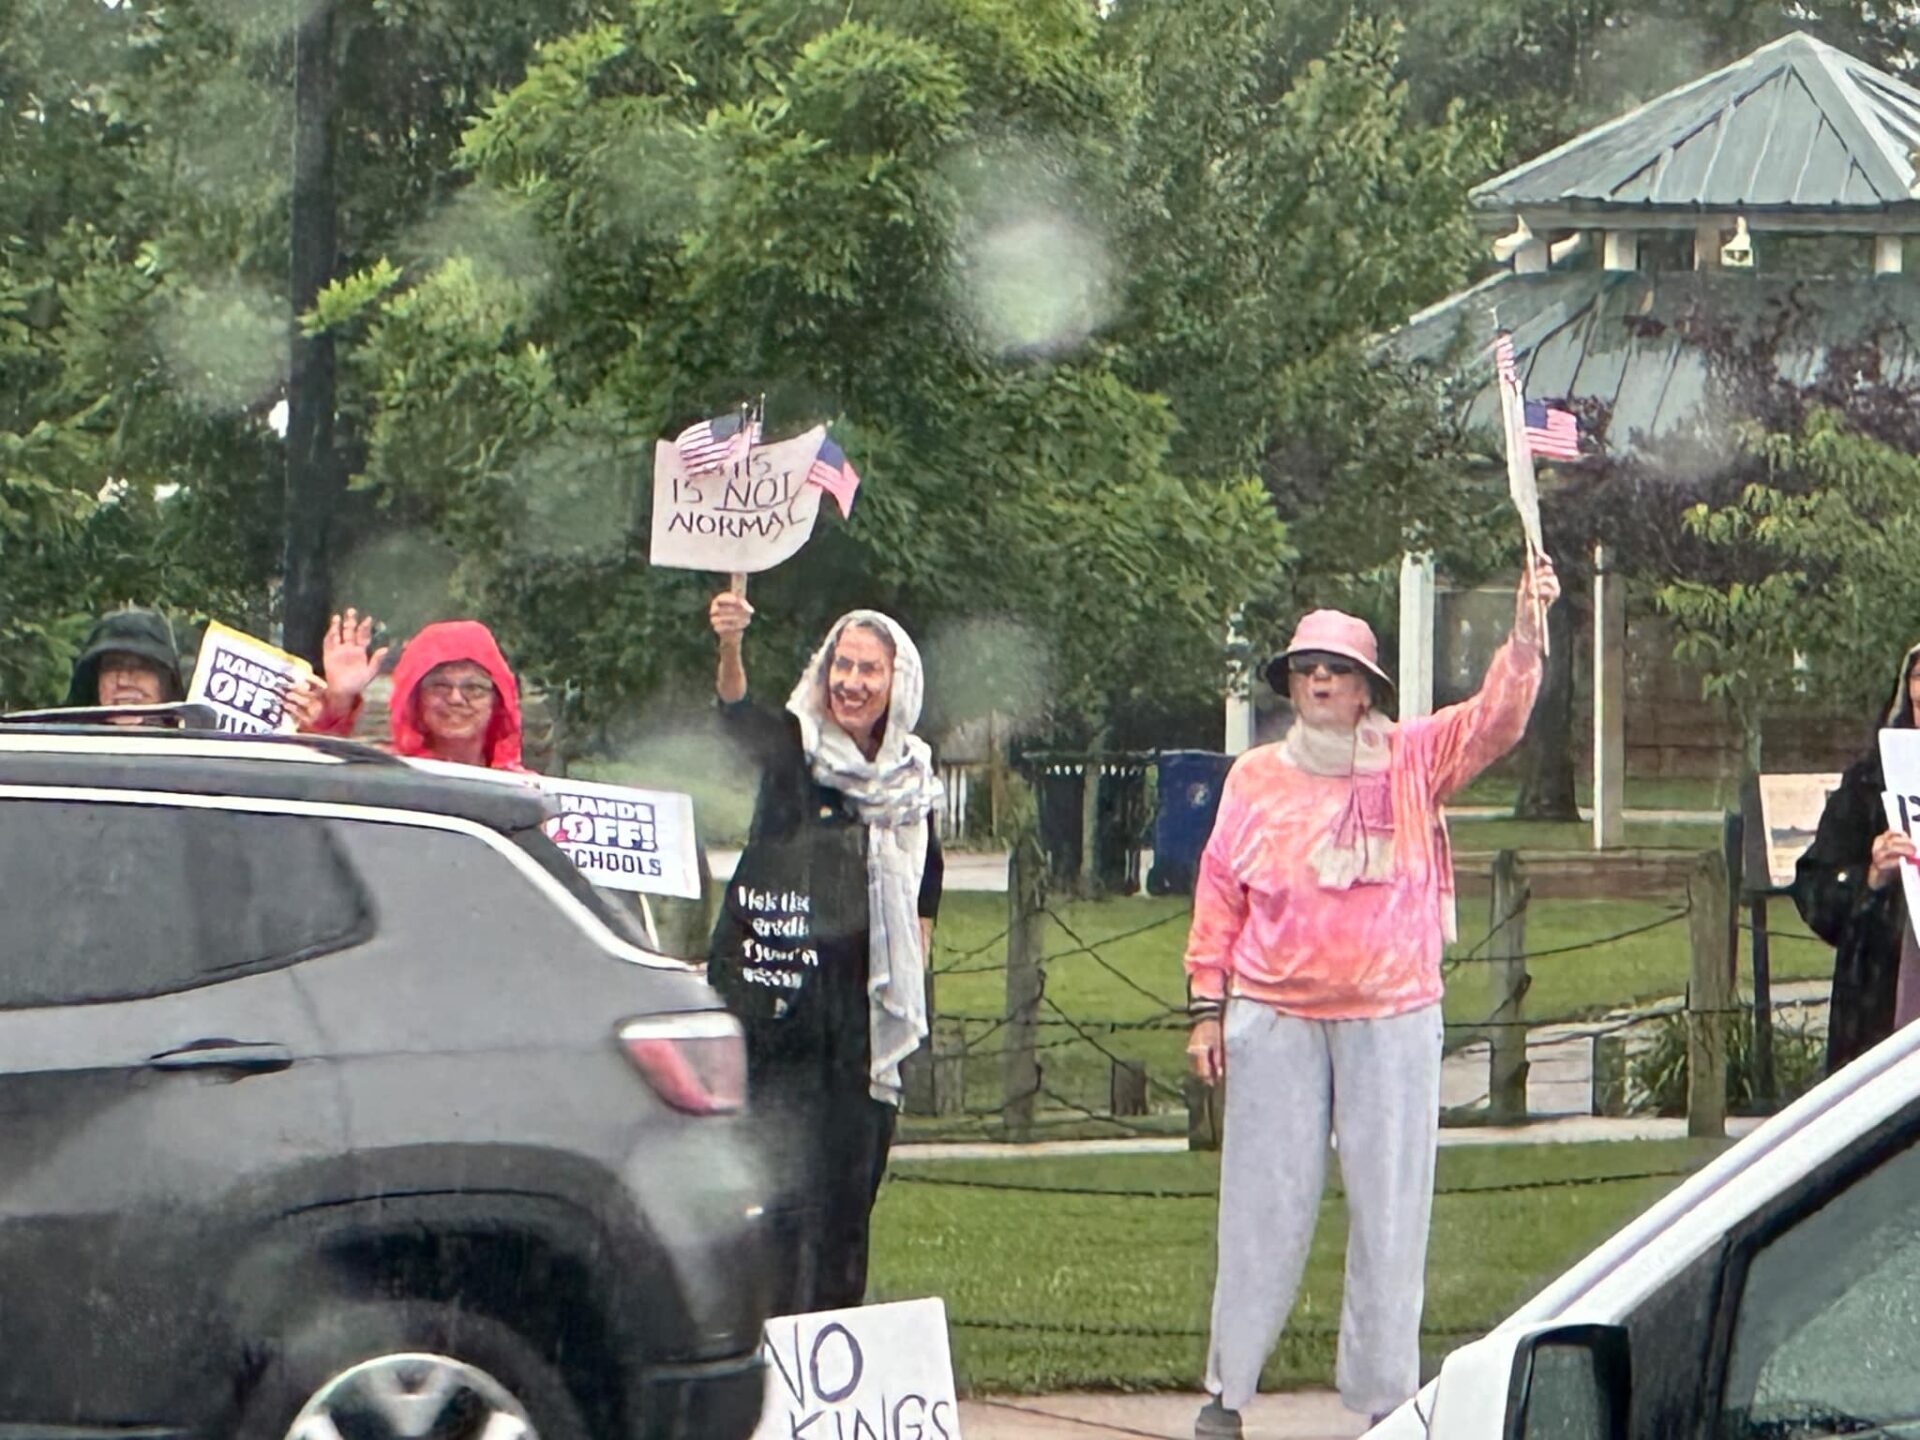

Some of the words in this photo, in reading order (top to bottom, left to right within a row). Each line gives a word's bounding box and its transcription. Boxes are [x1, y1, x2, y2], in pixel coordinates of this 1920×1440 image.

[673, 478, 703, 504] IS
[722, 470, 793, 510] NOT
[668, 487, 807, 543] NORMAL
[560, 812, 656, 851] OFF!
[561, 848, 662, 877] CHOOLS
[764, 1321, 864, 1410] NO
